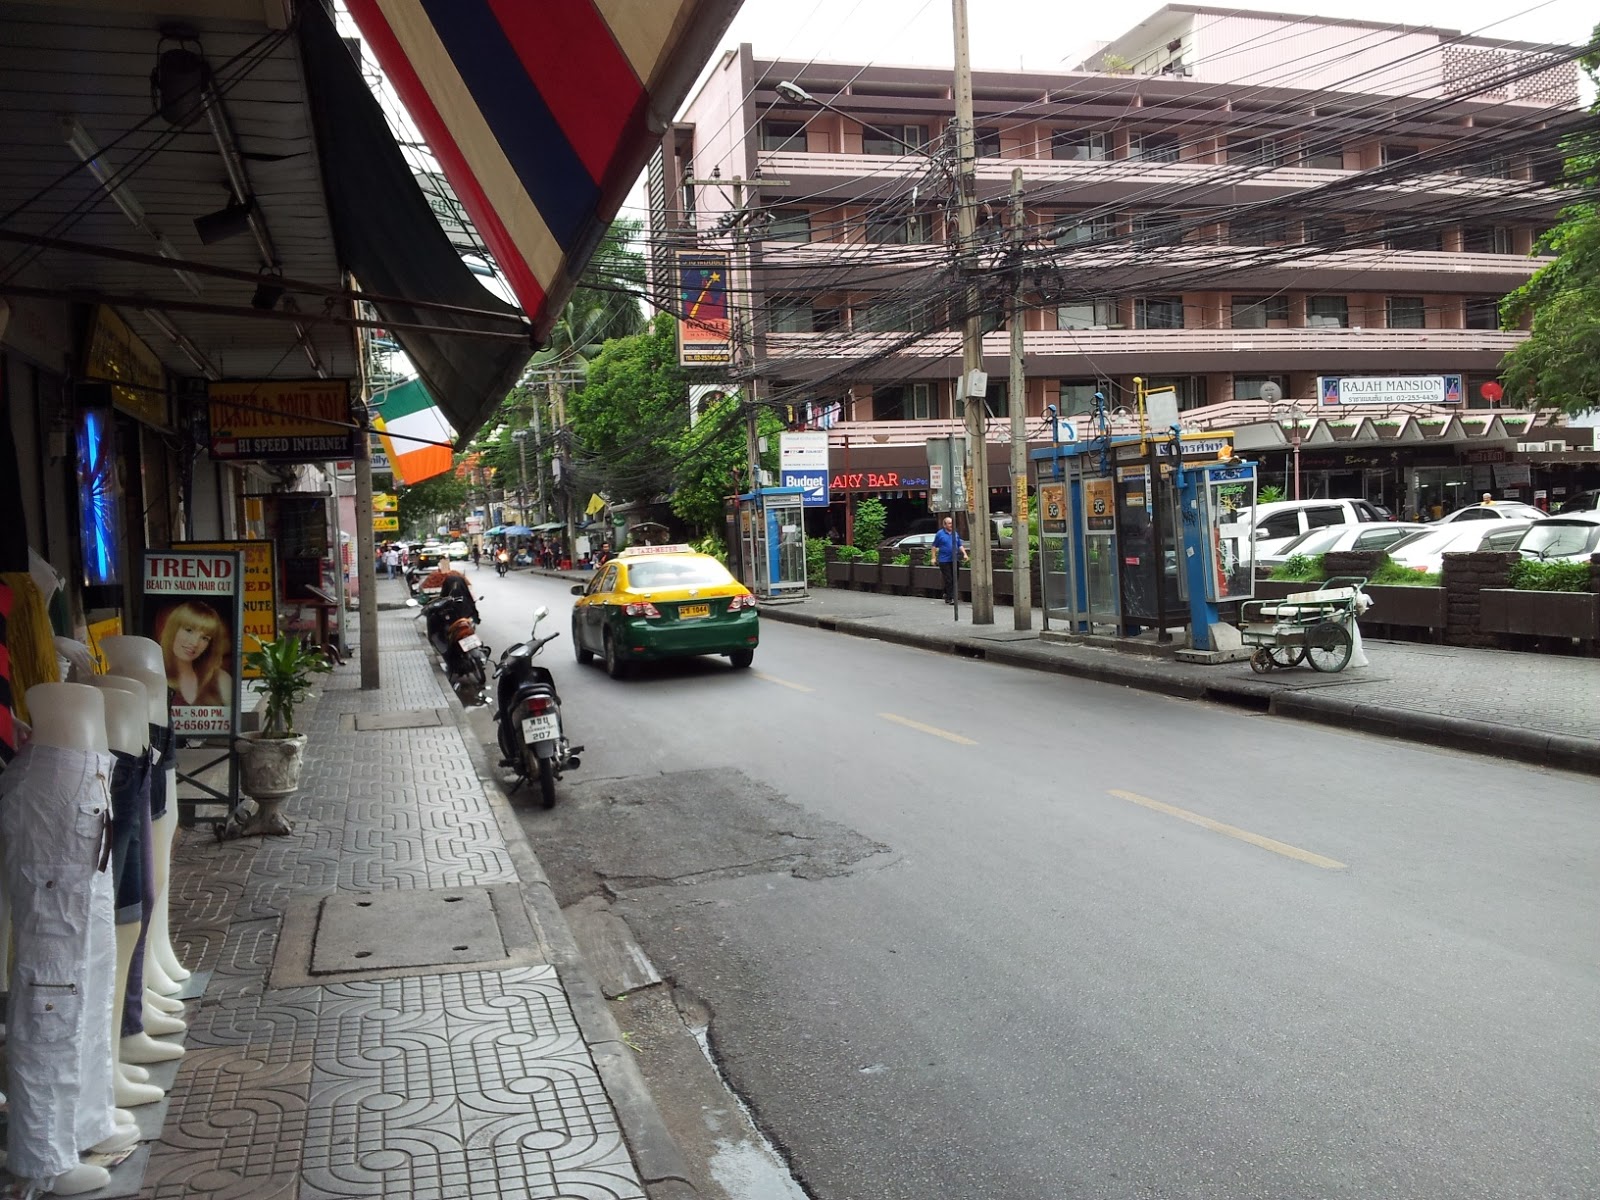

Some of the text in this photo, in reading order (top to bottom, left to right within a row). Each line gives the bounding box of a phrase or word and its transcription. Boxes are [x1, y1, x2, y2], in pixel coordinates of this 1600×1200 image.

[1342, 379, 1442, 392] RAJAH MANSION
[238, 437, 348, 453] HI SPEED INTERNET
[1180, 441, 1223, 453] ทรศัพท์
[786, 475, 824, 487] Budget
[828, 473, 863, 488] ARY
[867, 472, 899, 487] BAR
[146, 558, 232, 578] TREND
[146, 580, 231, 591] BEAUTY SALON HAIR CUT
[243, 624, 273, 635] CALL
[190, 708, 209, 718] 8.00
[211, 708, 224, 718] PM.
[532, 730, 551, 740] 207
